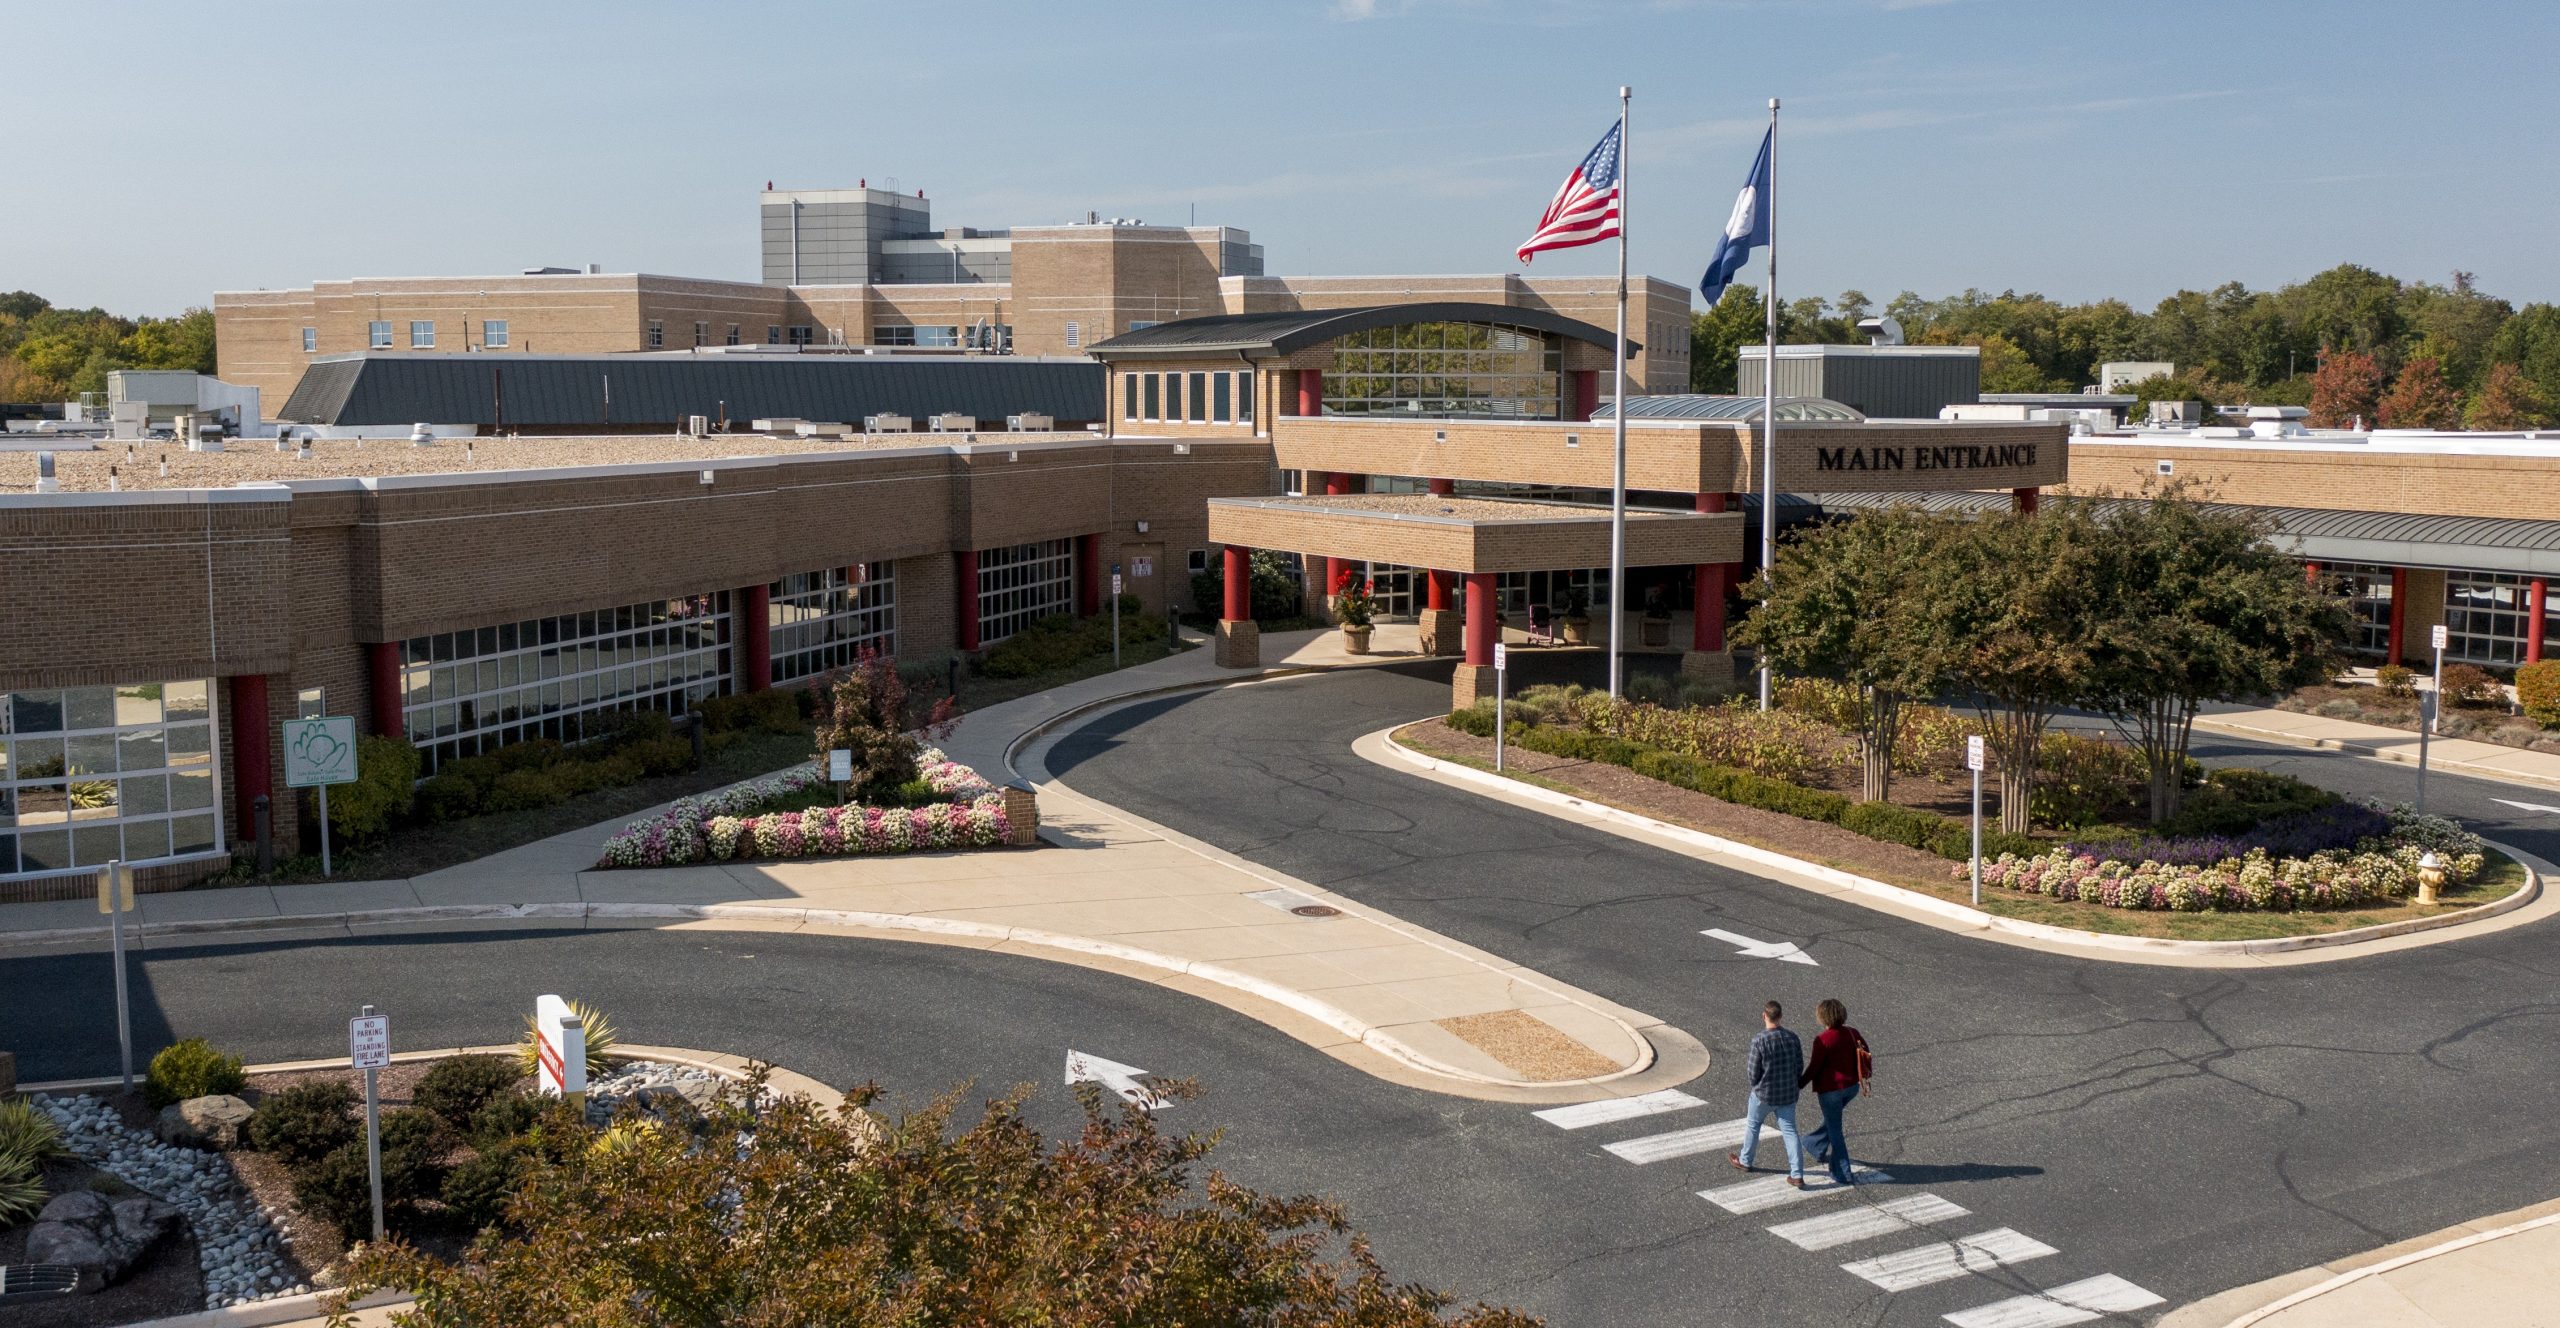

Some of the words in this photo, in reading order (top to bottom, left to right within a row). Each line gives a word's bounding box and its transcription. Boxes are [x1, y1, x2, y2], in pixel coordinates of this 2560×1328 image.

[1816, 447, 1905, 470] MAIN
[1914, 444, 2036, 469] ENTRANCE
[364, 1020, 375, 1029] NO
[357, 1028, 382, 1037] PARKING
[355, 1042, 385, 1052] STANDING
[356, 1051, 369, 1060] FIRE
[370, 1050, 385, 1060] LANE
